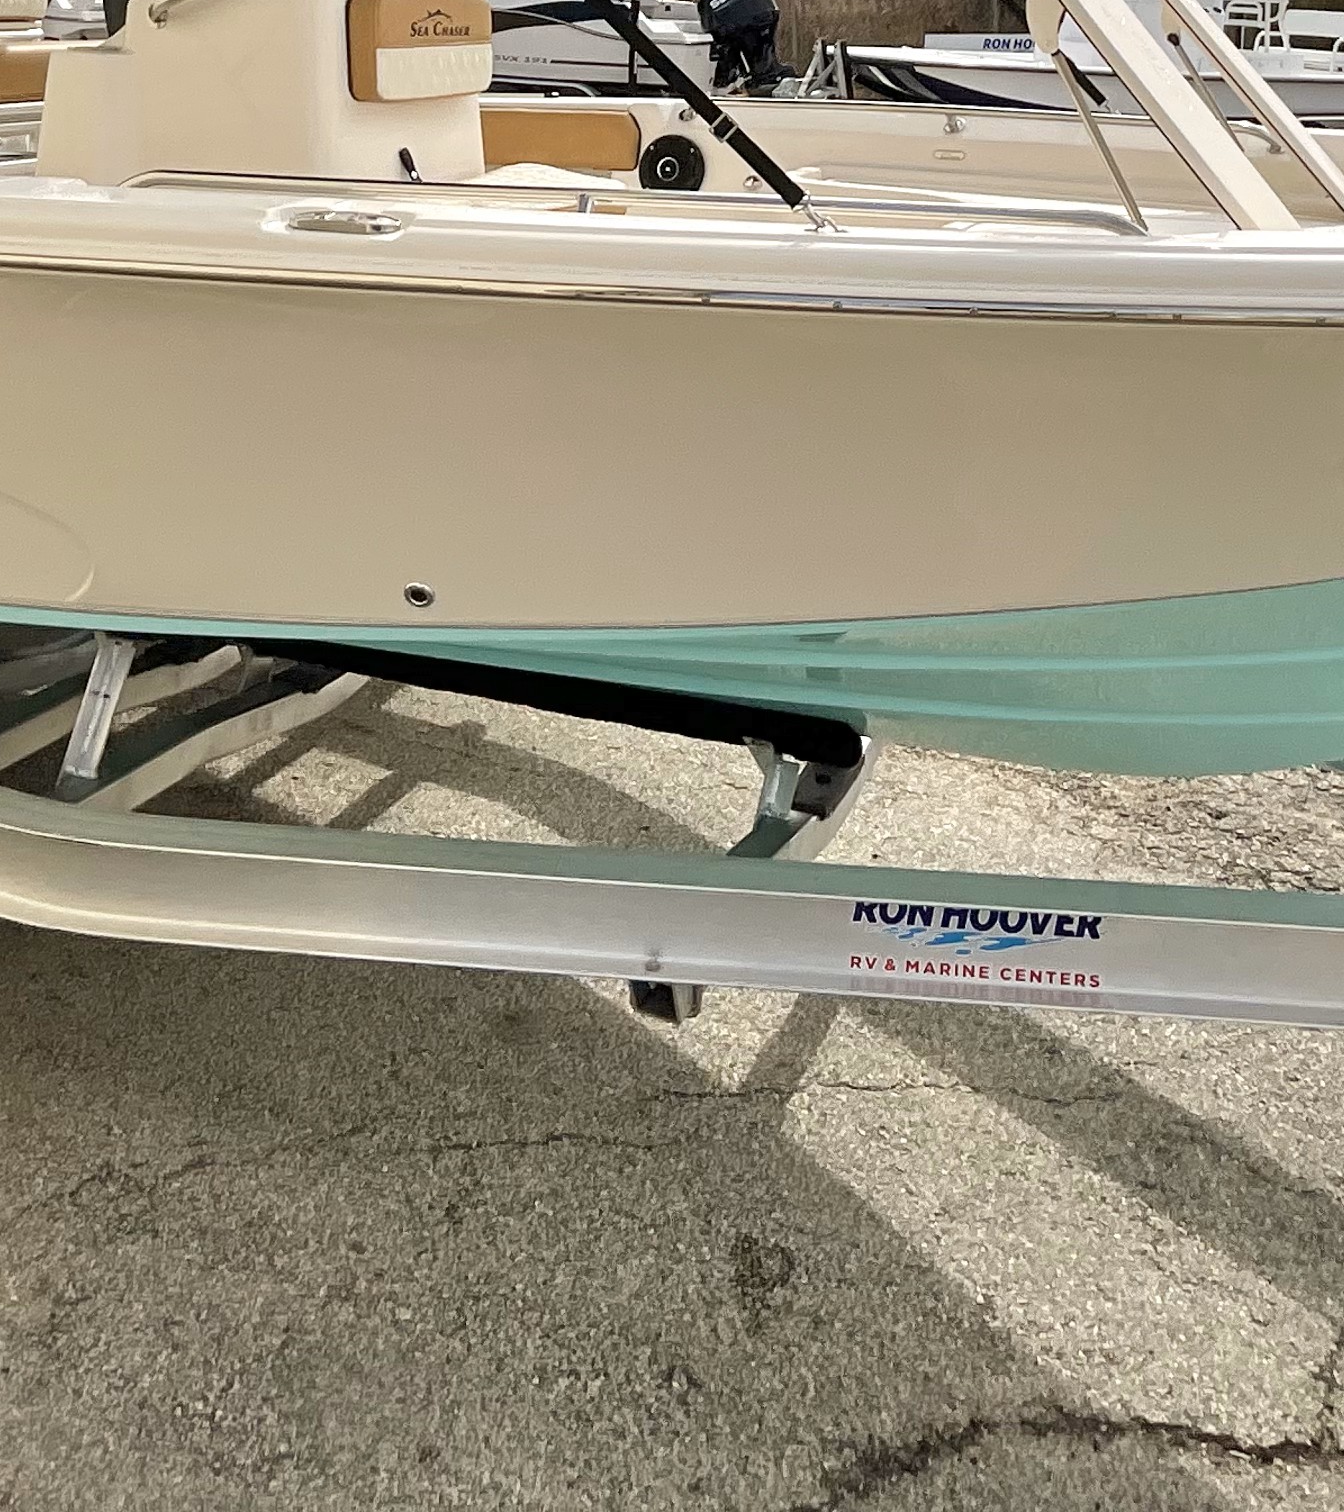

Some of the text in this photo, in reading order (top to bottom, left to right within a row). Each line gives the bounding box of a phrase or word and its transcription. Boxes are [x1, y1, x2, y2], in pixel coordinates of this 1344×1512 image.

[410, 21, 470, 37] SEA CHASER
[982, 38, 1035, 50] RON HO
[852, 901, 1102, 939] RON HOOVER
[850, 955, 1100, 988] RV & MARINE CENTERS
